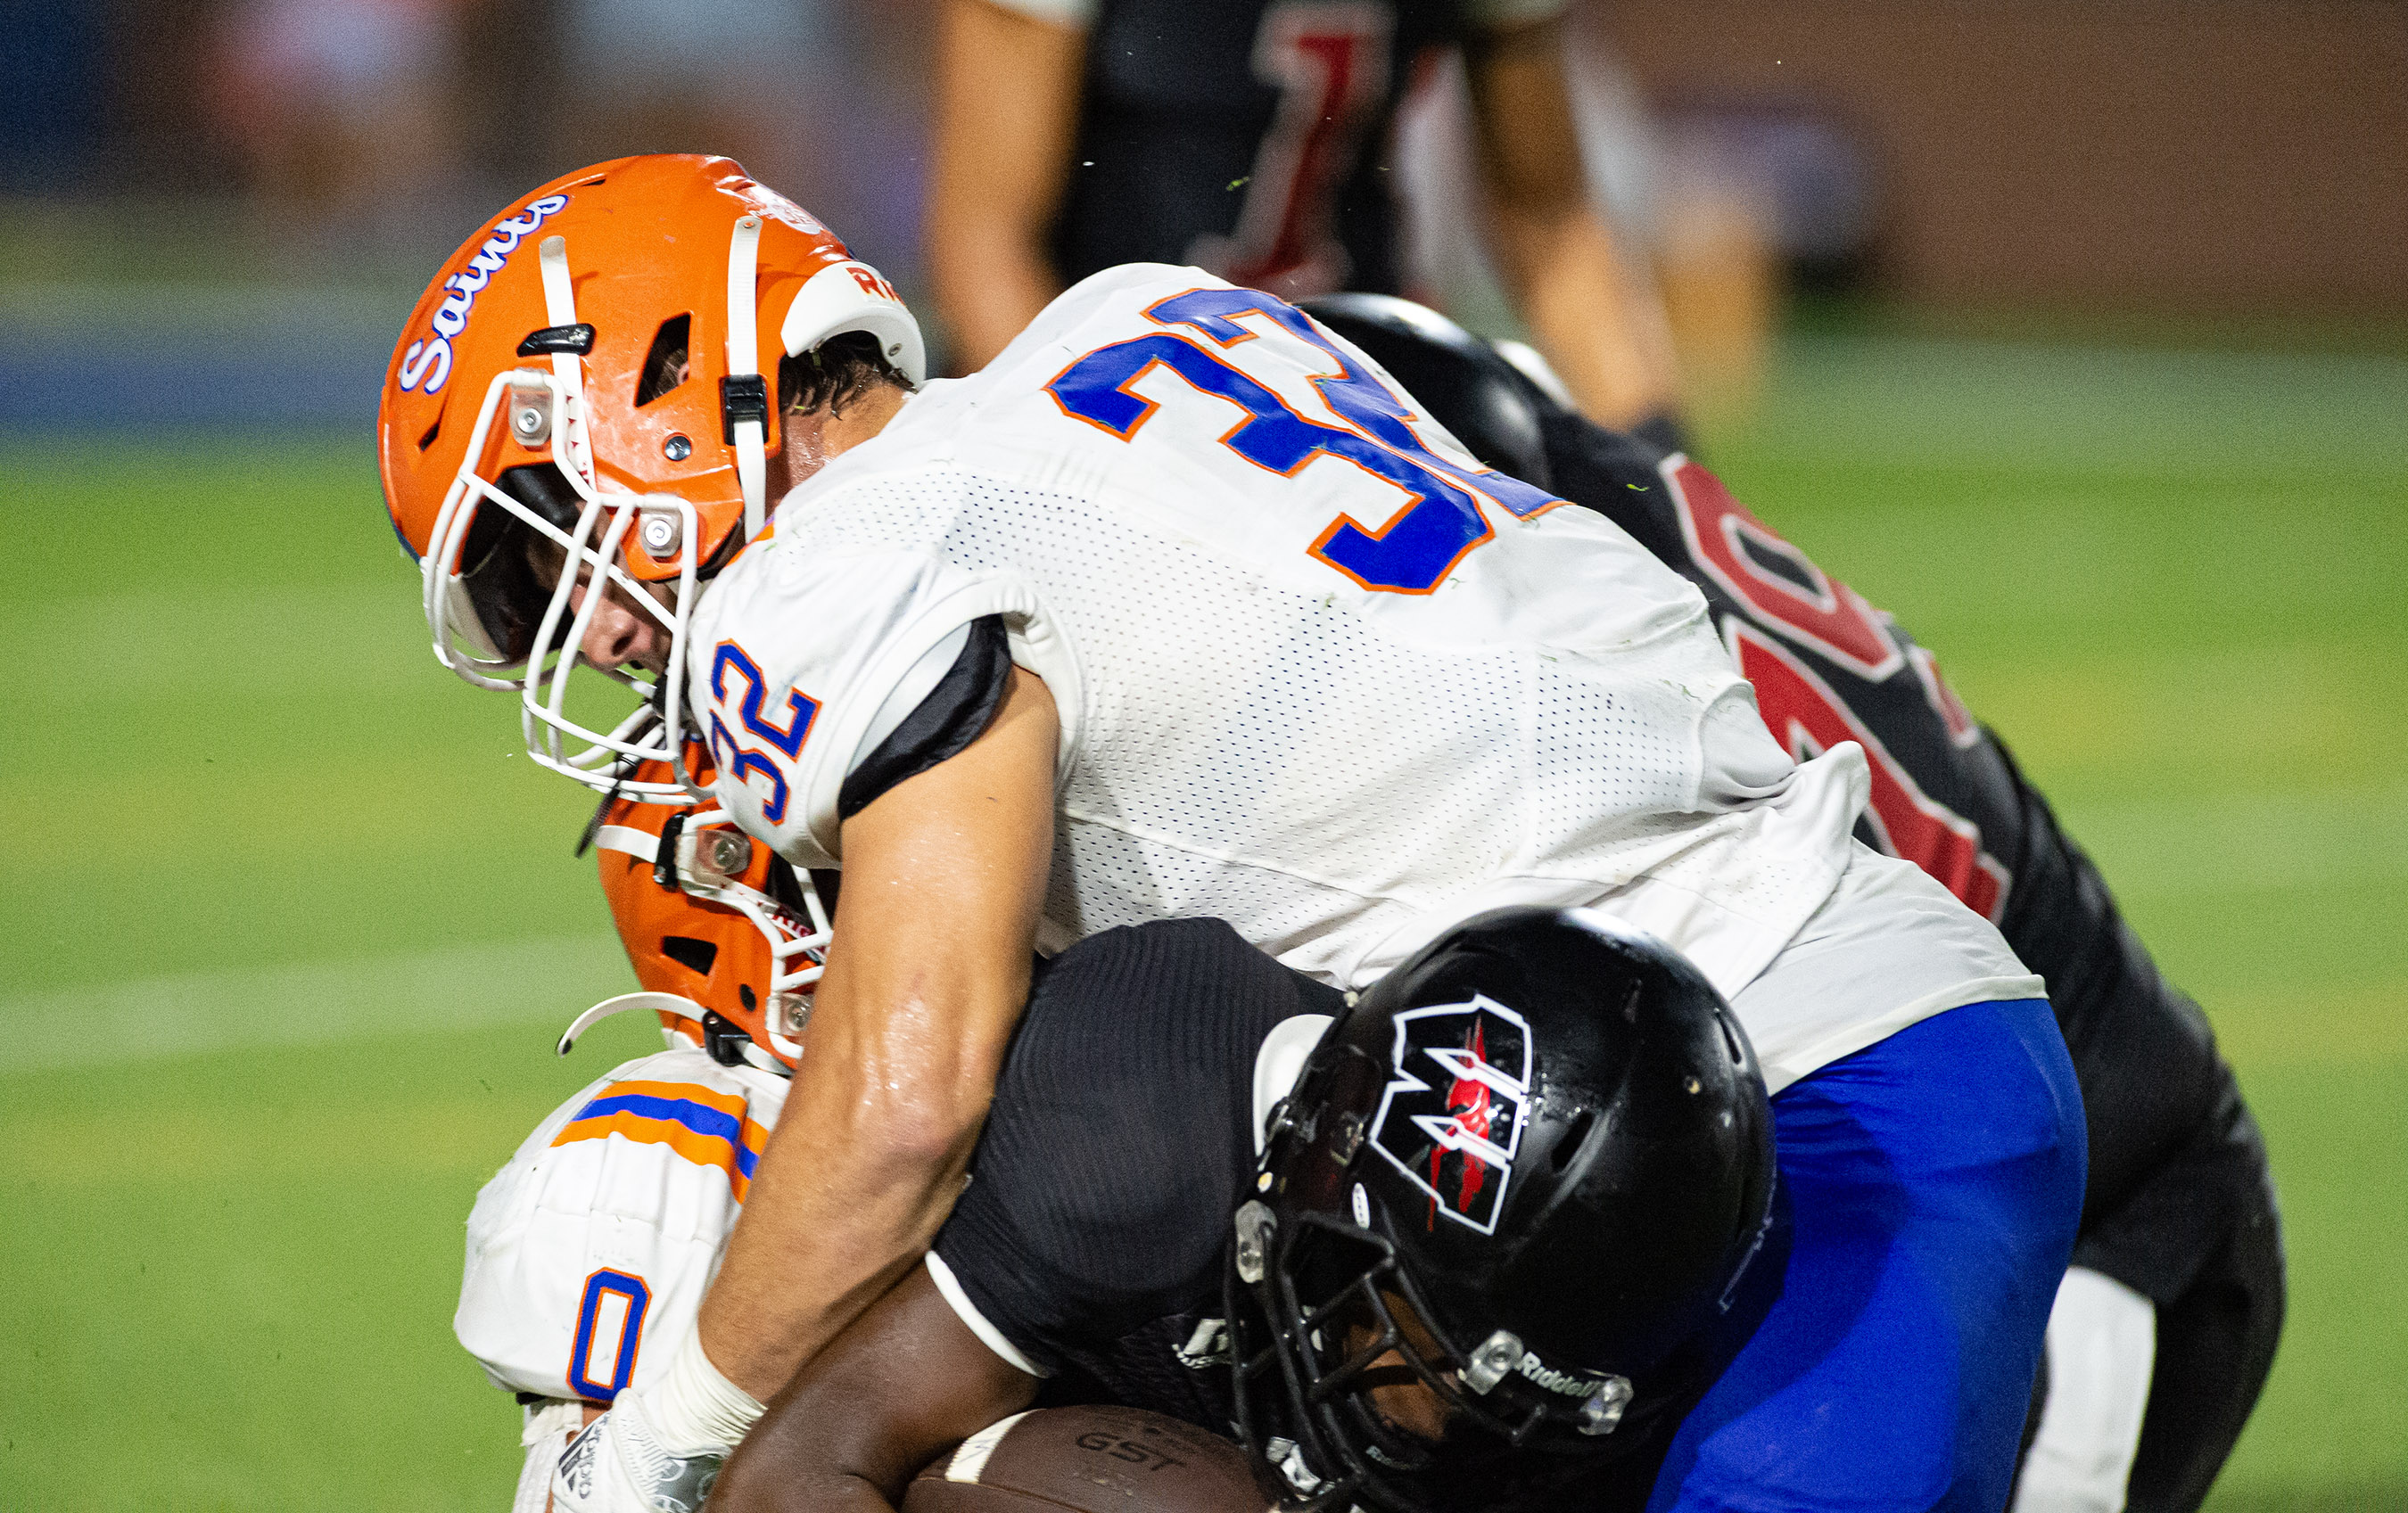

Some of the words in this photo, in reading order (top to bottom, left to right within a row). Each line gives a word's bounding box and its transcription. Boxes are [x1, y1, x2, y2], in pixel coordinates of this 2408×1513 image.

[399, 193, 569, 395] Saints
[1041, 287, 1577, 595] 32
[709, 637, 823, 826] 32
[566, 1266, 653, 1402] 0
[1516, 1352, 1601, 1397] Riddell
[1076, 1431, 1187, 1471] GST
